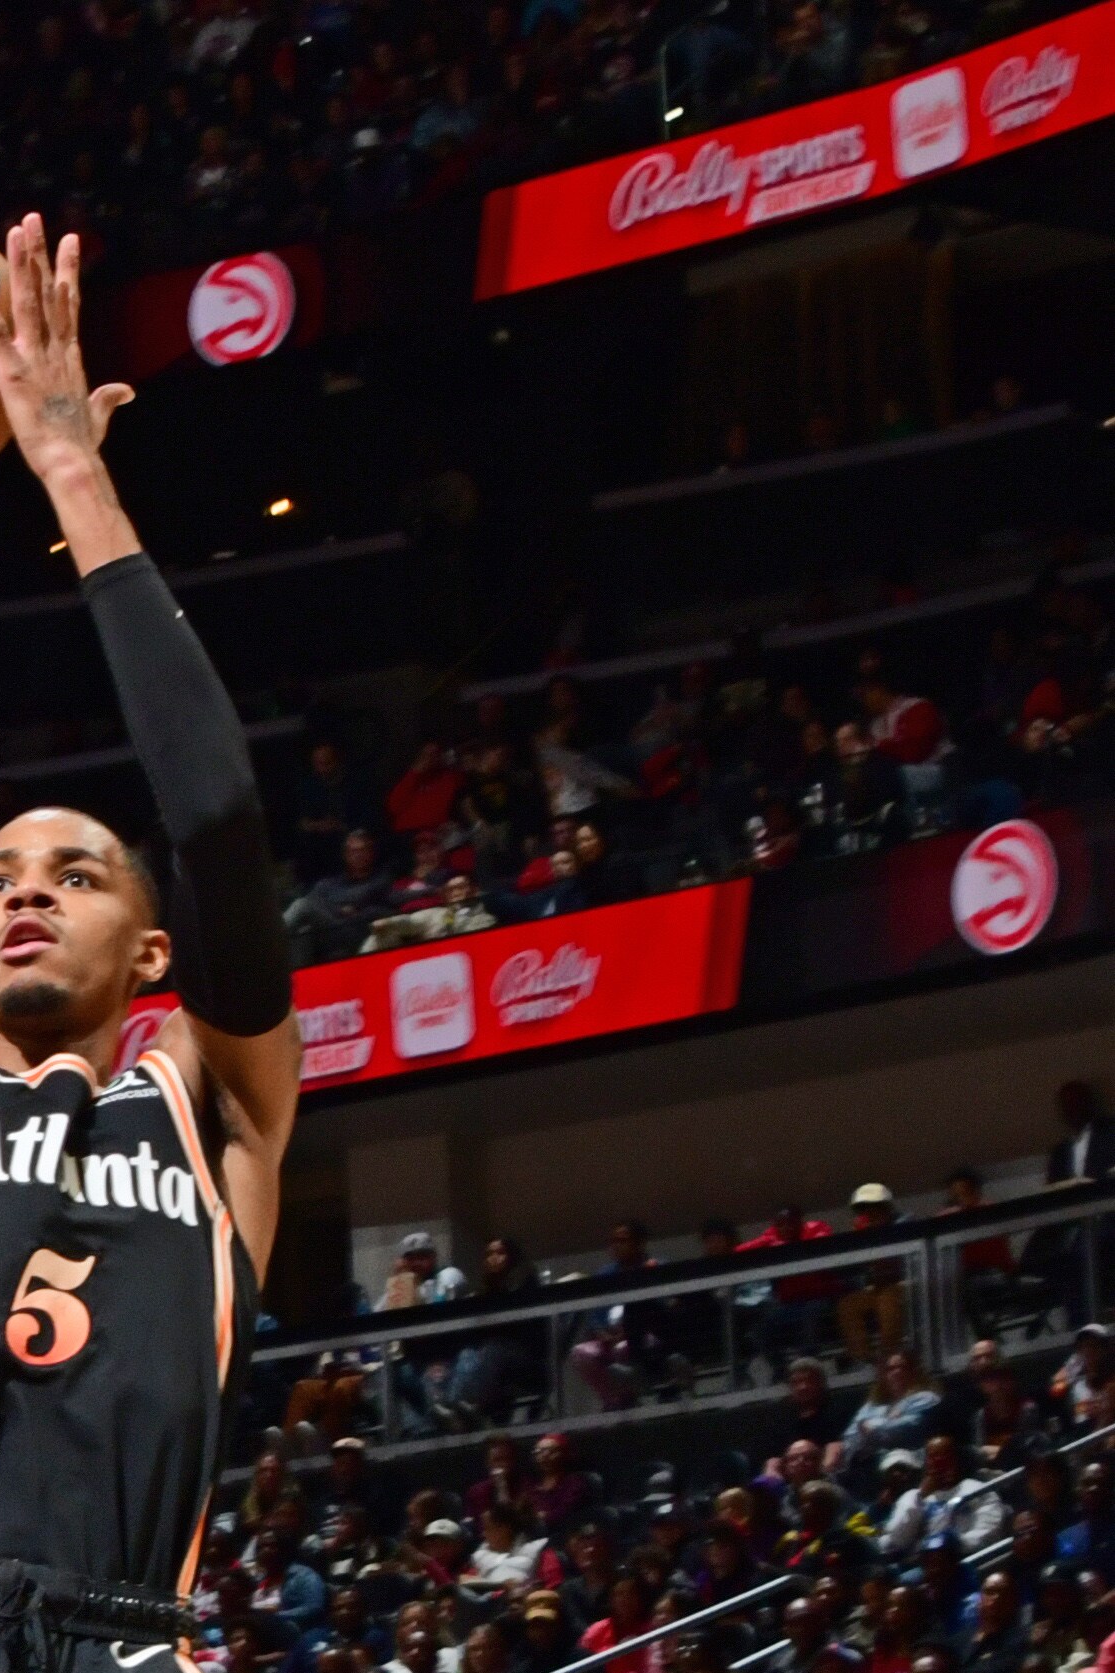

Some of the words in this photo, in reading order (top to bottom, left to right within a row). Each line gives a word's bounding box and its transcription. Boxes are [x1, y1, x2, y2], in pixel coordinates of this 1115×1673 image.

[608, 139, 751, 230] Bally
[753, 124, 866, 187] SPORTS
[5, 1247, 97, 1367] 5
